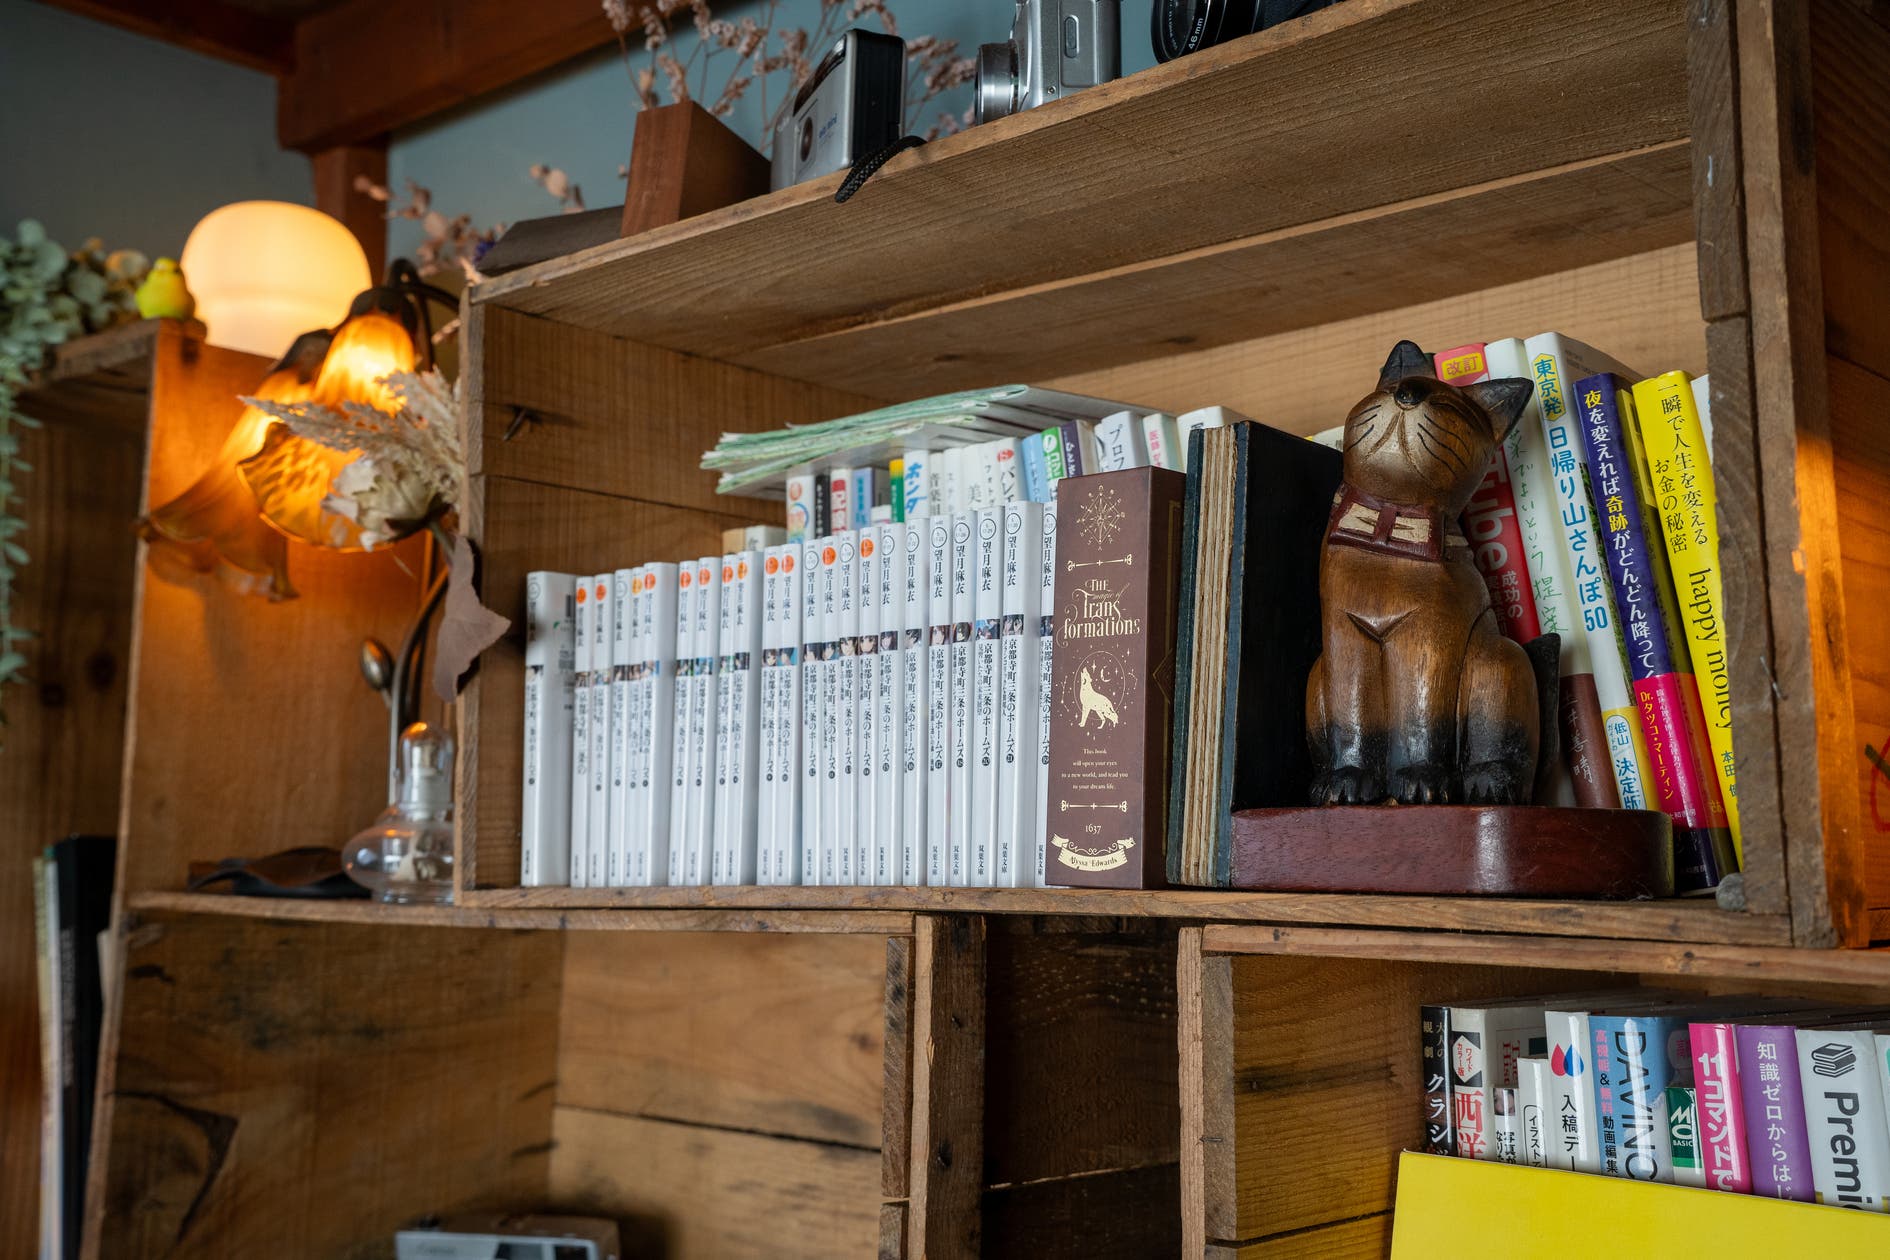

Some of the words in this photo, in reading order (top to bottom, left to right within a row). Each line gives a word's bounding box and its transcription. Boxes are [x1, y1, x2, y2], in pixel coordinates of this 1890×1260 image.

[1445, 354, 1479, 376] 改訂
[1534, 358, 1563, 419] 東京発
[1657, 383, 1708, 545] 一瞬で人生を変える
[1654, 458, 1688, 554] お金の秘密
[934, 549, 943, 599] 望月麻衣
[955, 545, 965, 595] 望月麻衣
[982, 541, 992, 591] 望月麻衣
[1007, 536, 1017, 586] 望月麻衣
[1500, 570, 1524, 619] 成功の
[1689, 567, 1720, 643] happy
[1060, 613, 1140, 643] formations
[982, 643, 993, 756] 京都寺町三条のホームズ
[1006, 638, 1018, 753] 京都寺町三条のホームズ
[1614, 721, 1630, 746] 低山
[1615, 757, 1641, 809] 決定版
[1085, 824, 1102, 834] 1637
[1091, 856, 1118, 868] Edwards
[1457, 1042, 1465, 1077] カラー版
[1465, 1047, 1473, 1072] ワイド
[1824, 1091, 1873, 1210] Premi
